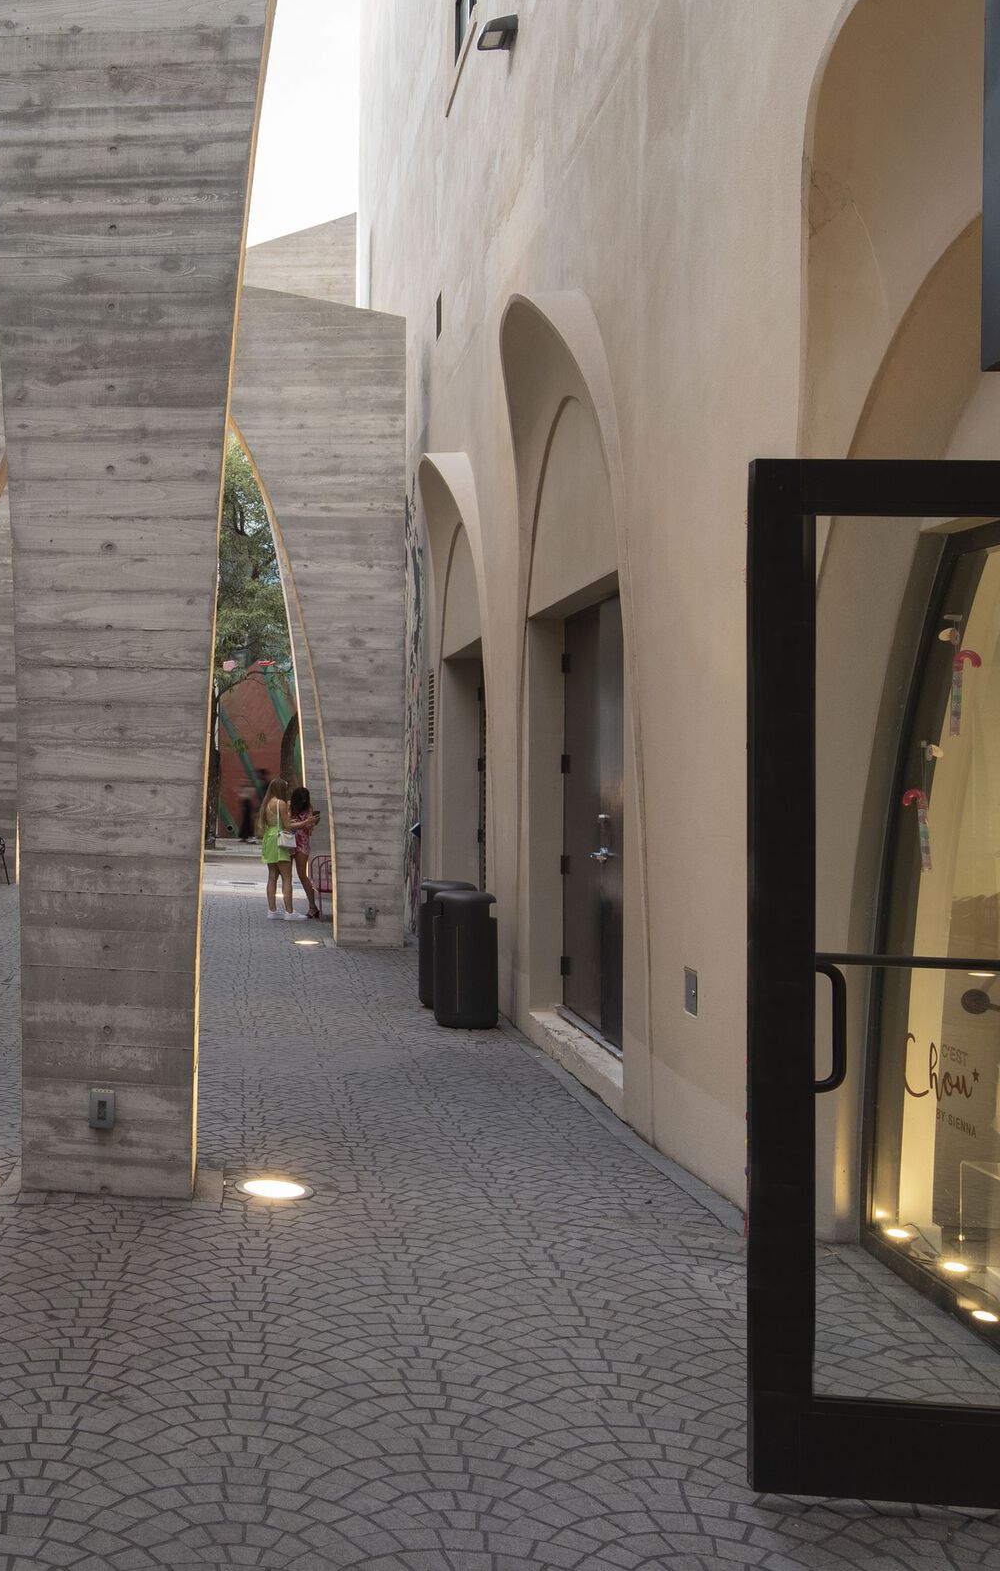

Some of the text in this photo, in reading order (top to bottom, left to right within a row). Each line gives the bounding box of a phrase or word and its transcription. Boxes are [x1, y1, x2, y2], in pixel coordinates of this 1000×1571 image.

[904, 1033, 973, 1101] Chou
[941, 1044, 968, 1067] C'EST
[936, 1108, 976, 1138] BY SIENNA
